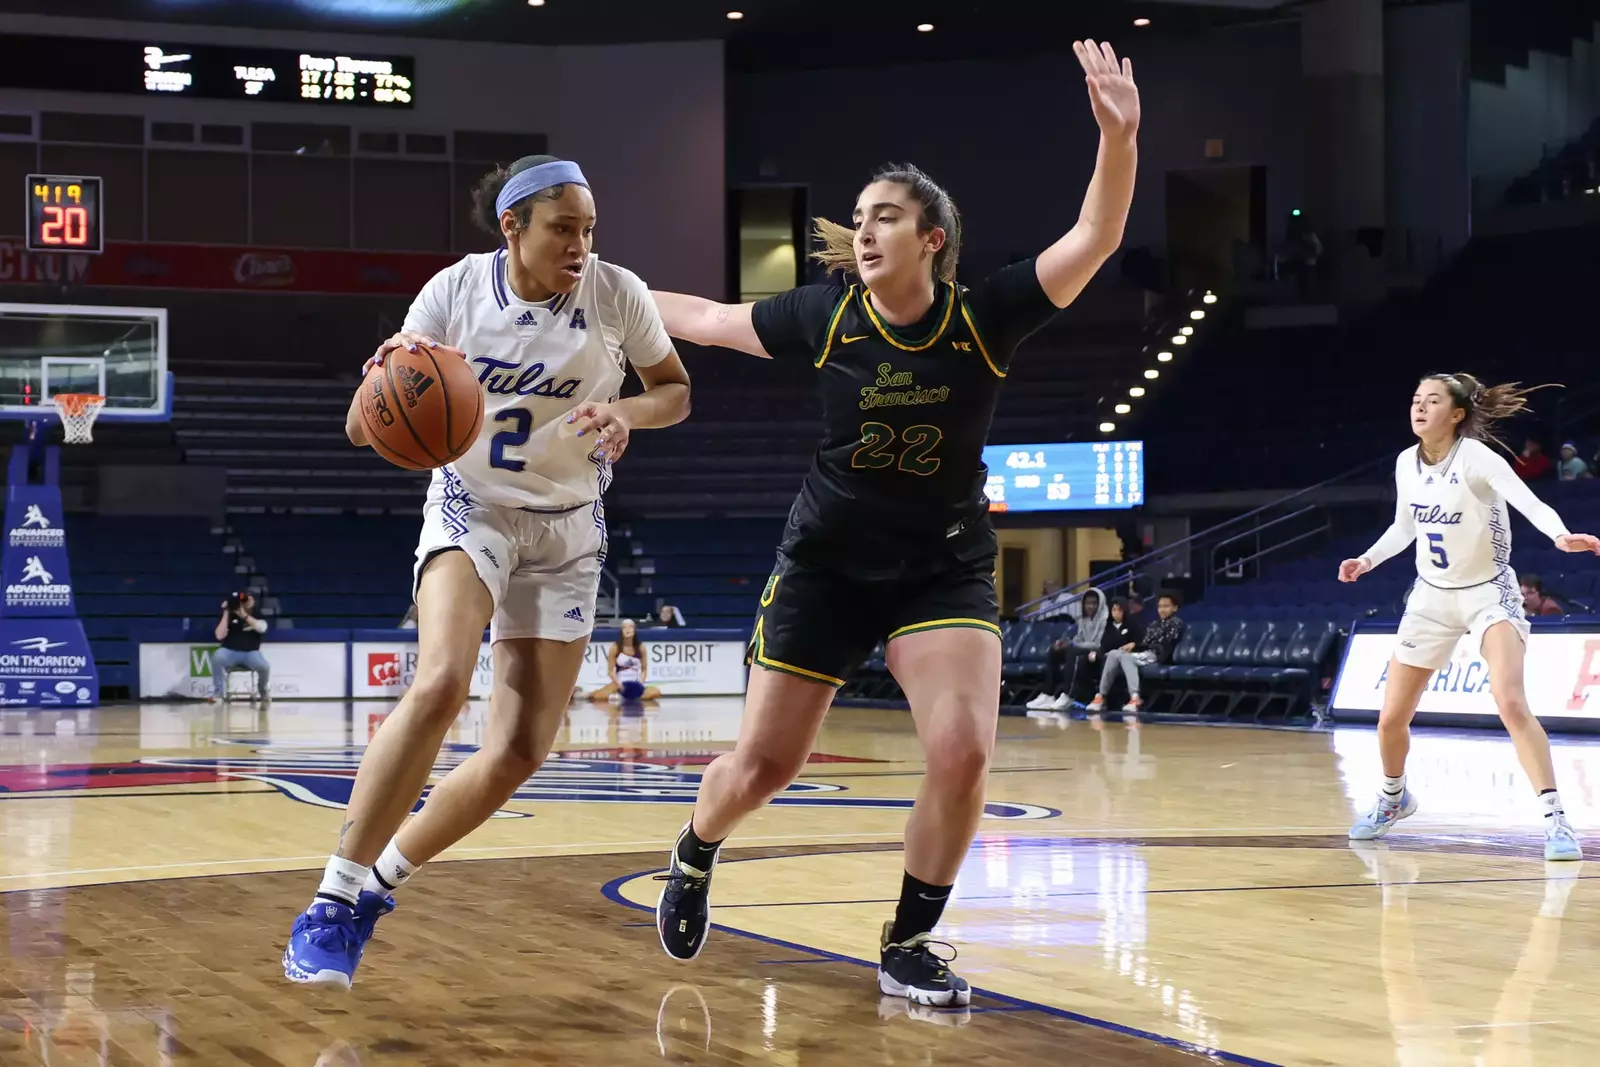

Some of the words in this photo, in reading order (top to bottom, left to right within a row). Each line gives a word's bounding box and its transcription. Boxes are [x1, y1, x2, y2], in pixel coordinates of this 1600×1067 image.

[42, 206, 87, 245] 20
[396, 364, 418, 409] adidas
[472, 356, 583, 399] Tulsa
[875, 362, 913, 387] San
[371, 376, 395, 427] PRO
[859, 385, 951, 410] Francisco
[489, 408, 533, 472] 2
[851, 421, 944, 476] 22
[1409, 503, 1464, 525] Tulsa
[9, 528, 65, 536] ADVANCED
[479, 545, 500, 570] Tulsa
[1426, 532, 1449, 569] 5
[6, 584, 71, 594] ADVANCED
[0, 655, 19, 667] ON
[21, 655, 87, 667] THORNTON
[651, 644, 714, 663] SPIRIT
[652, 666, 697, 678] RESORT
